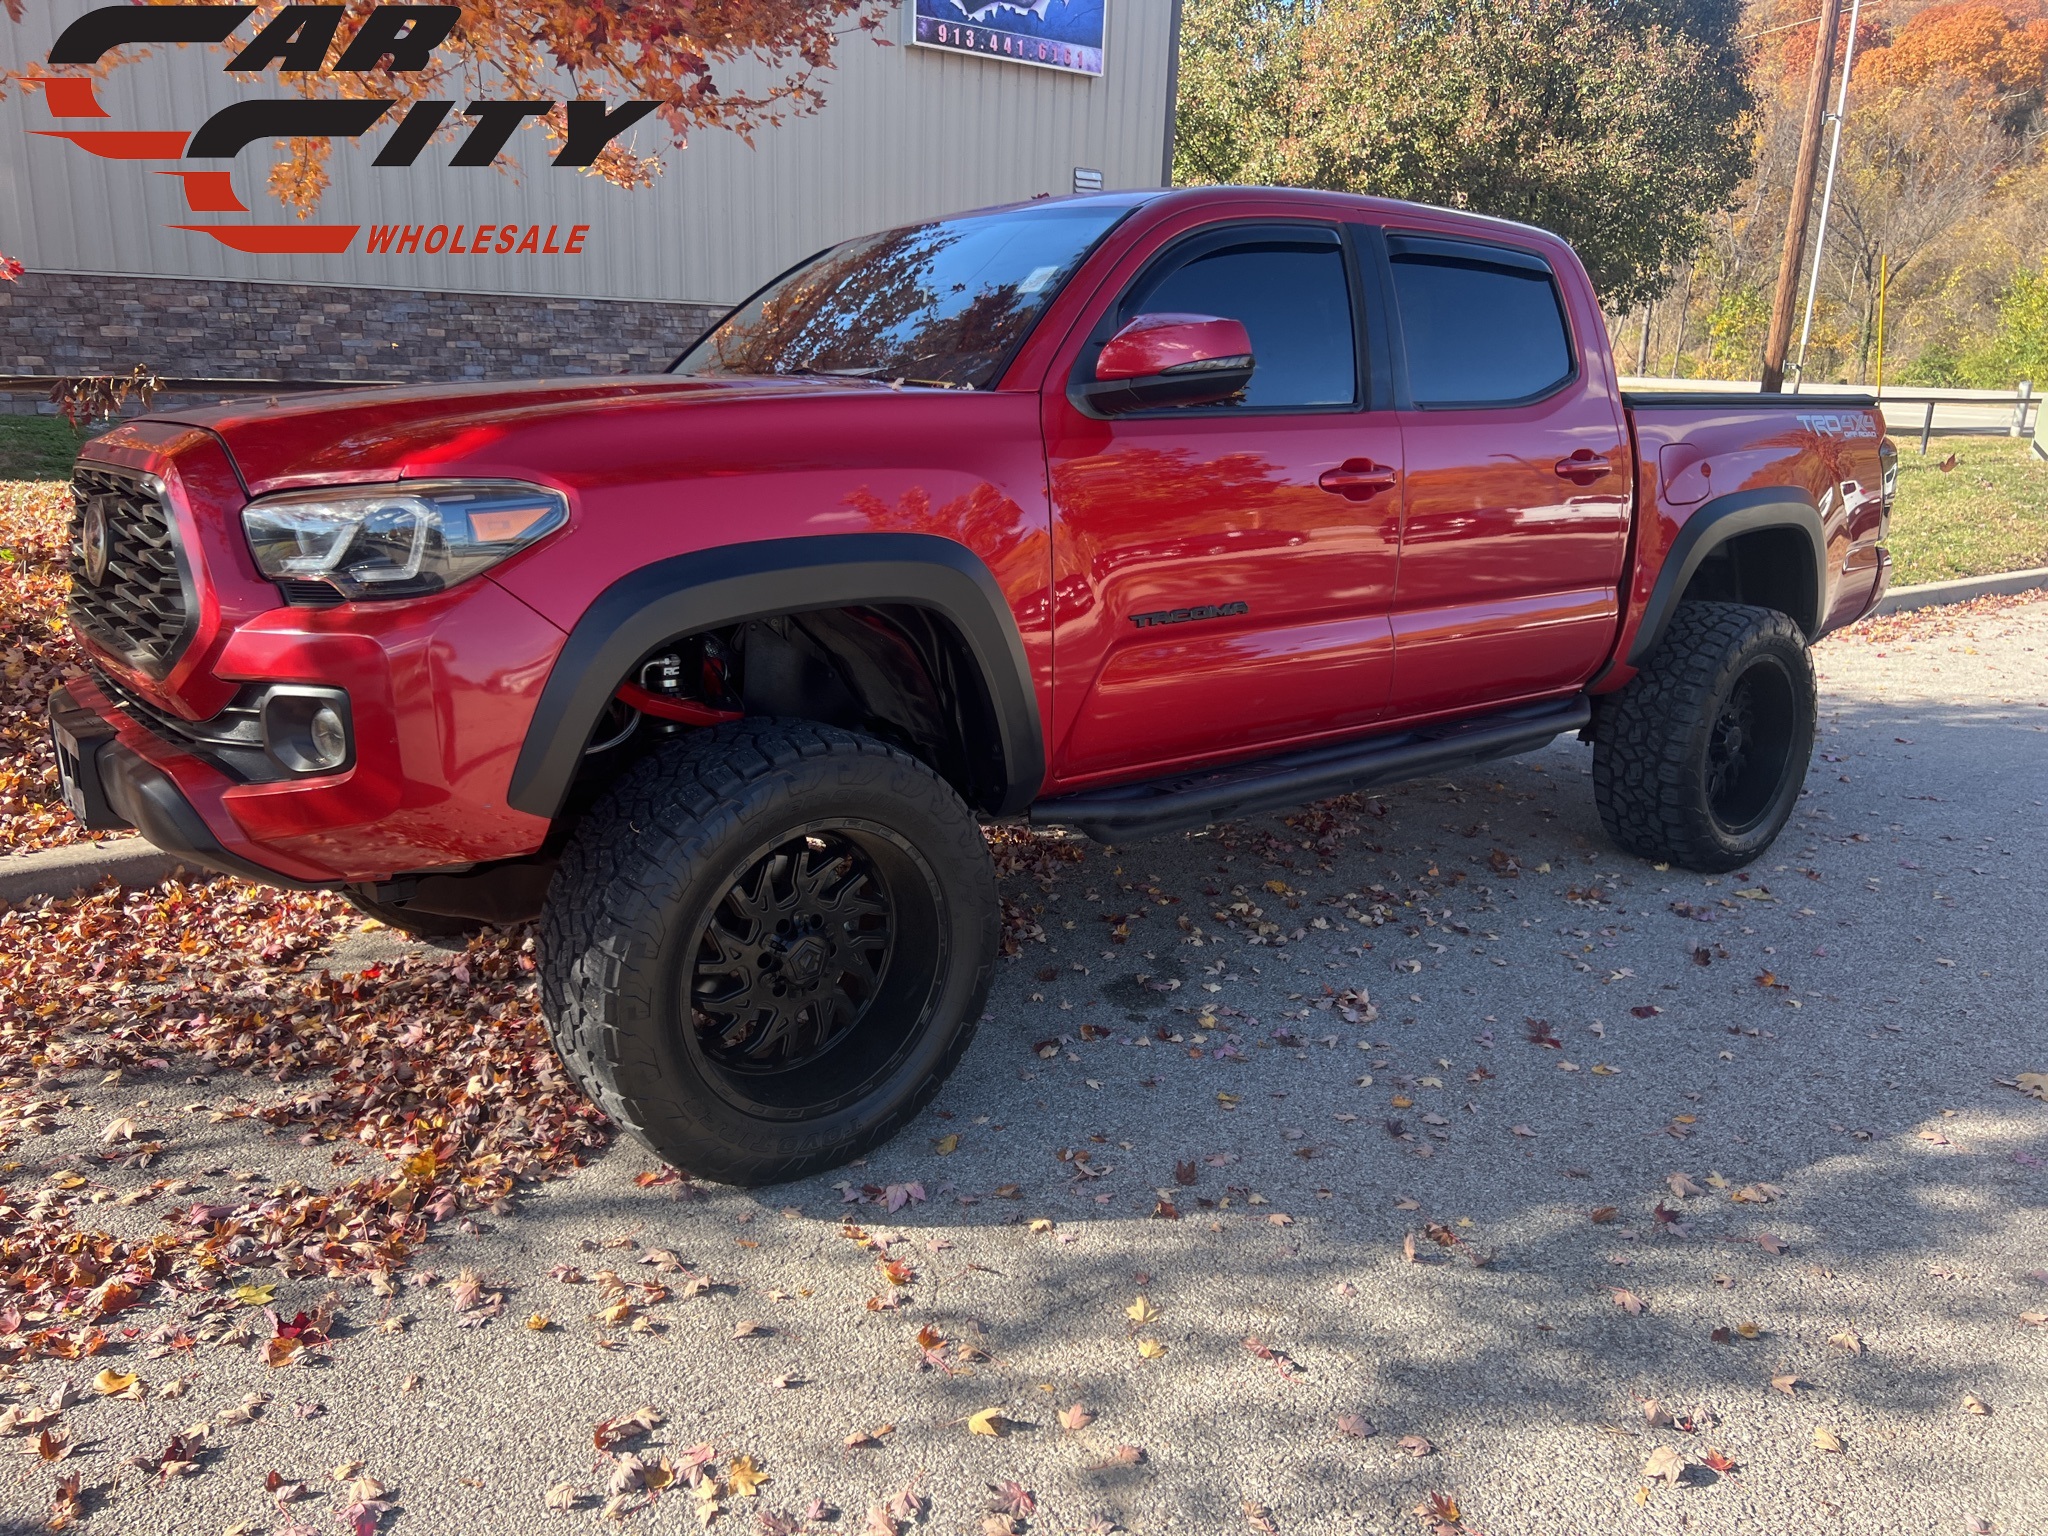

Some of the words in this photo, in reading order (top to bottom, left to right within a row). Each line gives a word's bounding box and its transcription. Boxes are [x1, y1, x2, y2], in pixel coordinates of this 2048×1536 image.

[1796, 415, 1841, 437] TRD
[1128, 601, 1249, 629] TACOMA
[663, 666, 680, 676] RC
